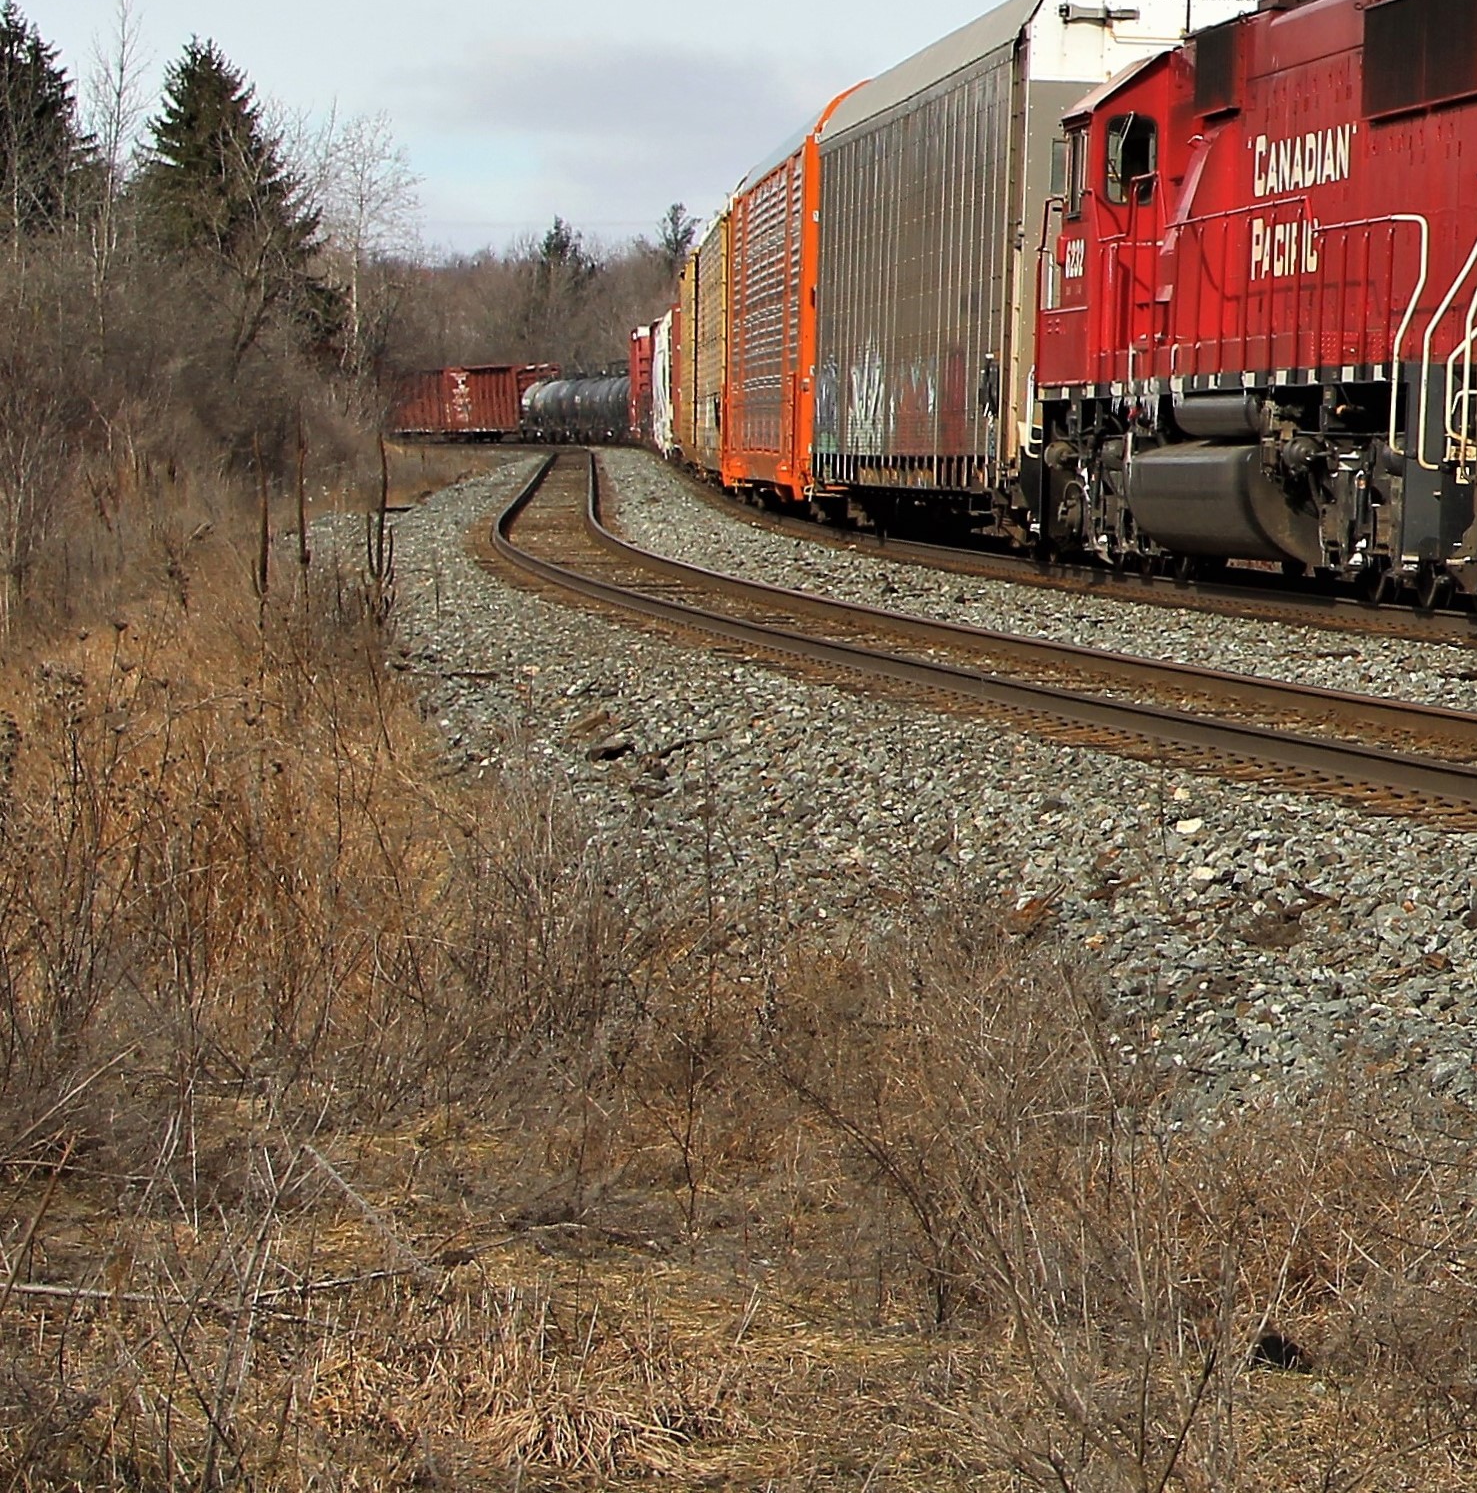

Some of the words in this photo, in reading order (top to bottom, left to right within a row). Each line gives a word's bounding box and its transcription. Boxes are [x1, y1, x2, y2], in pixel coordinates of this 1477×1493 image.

[1254, 123, 1350, 198] CANADIAN
[1065, 238, 1085, 279] 6232
[1251, 218, 1319, 281] PACIFIC
